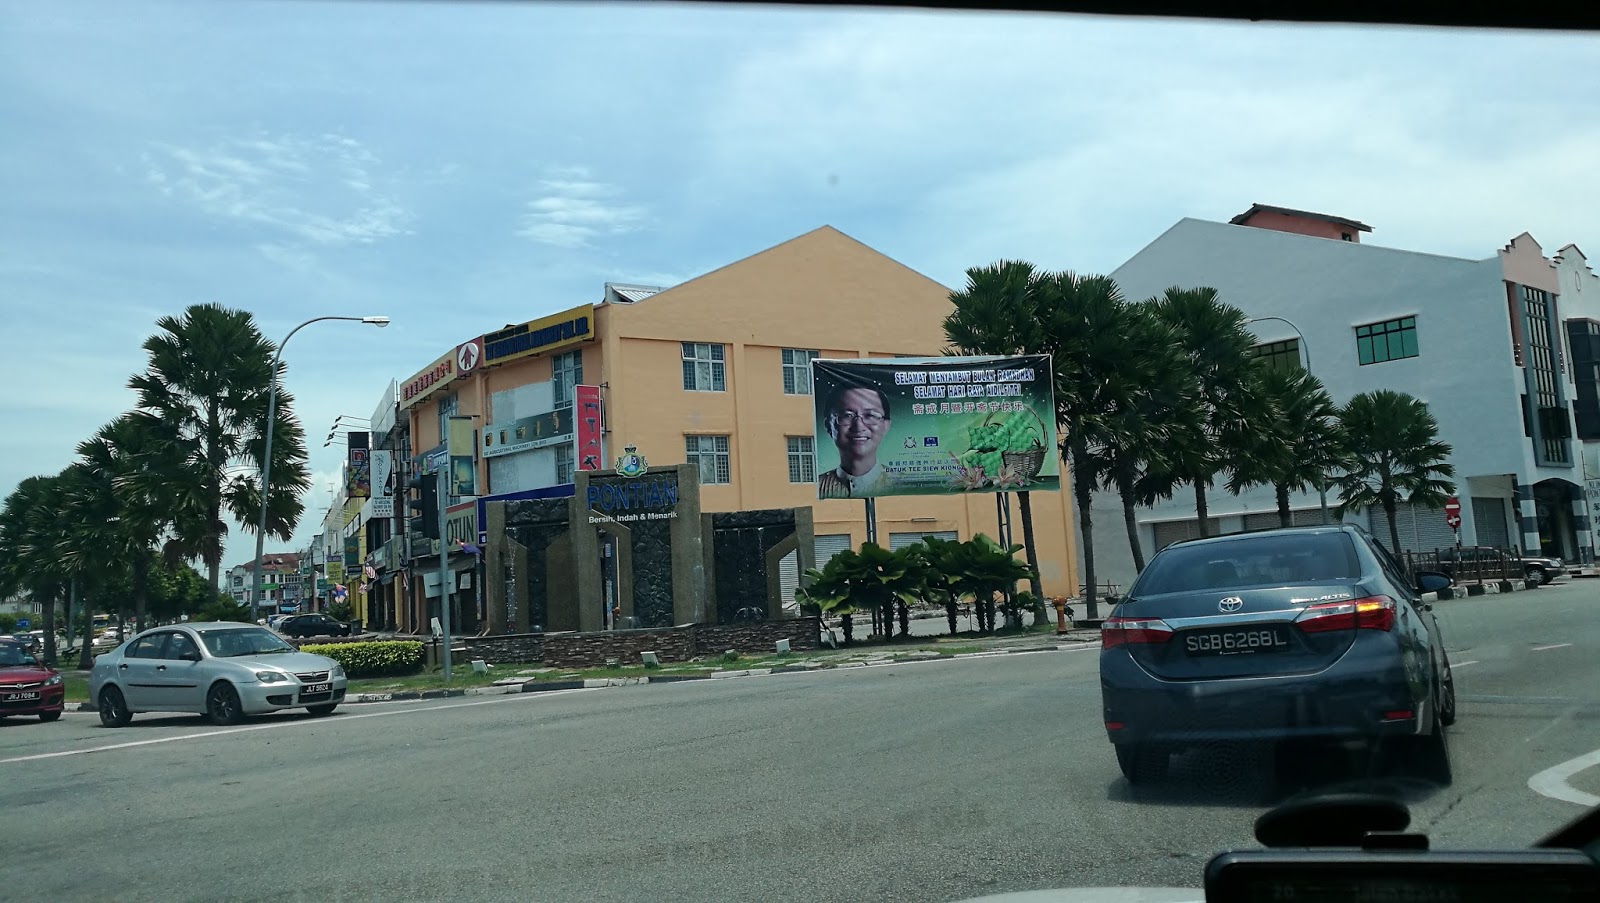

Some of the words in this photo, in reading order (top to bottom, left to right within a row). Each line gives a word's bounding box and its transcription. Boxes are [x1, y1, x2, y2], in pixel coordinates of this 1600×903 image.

[894, 372, 927, 385] SELAMAT
[928, 370, 971, 384] MENYAMBUT
[972, 370, 996, 382] BULAN
[997, 368, 1035, 382] RAMADHAN
[914, 385, 946, 398] SELAMAT
[948, 385, 966, 398] HARI
[967, 385, 985, 397] RAYA
[986, 383, 1022, 397] AIDILFITRI
[586, 480, 678, 511] PONTIAN
[588, 516, 615, 524] Bersih,
[617, 513, 638, 522] Indah
[647, 511, 678, 520] Menarik
[1186, 630, 1287, 651] SGB6268L
